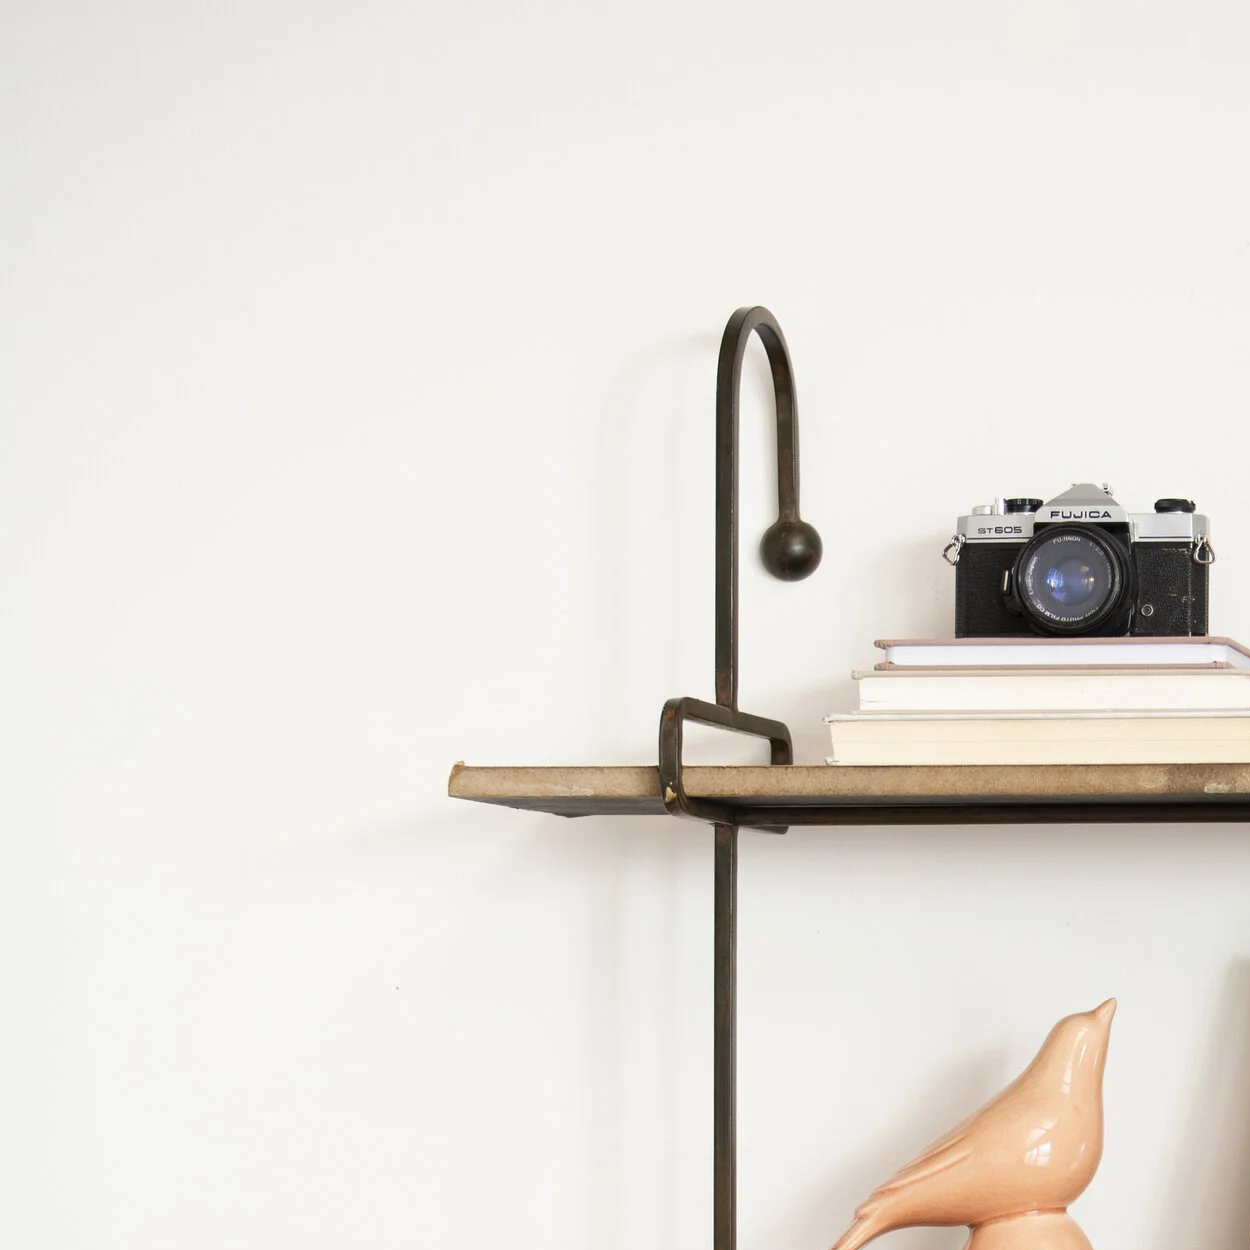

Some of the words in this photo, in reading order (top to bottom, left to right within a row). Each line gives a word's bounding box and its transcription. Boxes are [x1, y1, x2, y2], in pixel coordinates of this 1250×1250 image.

[1050, 510, 1112, 519] FUJICA
[977, 526, 1023, 534] ST605
[1052, 535, 1081, 544] FUJINON
[1044, 610, 1060, 621] FILM
